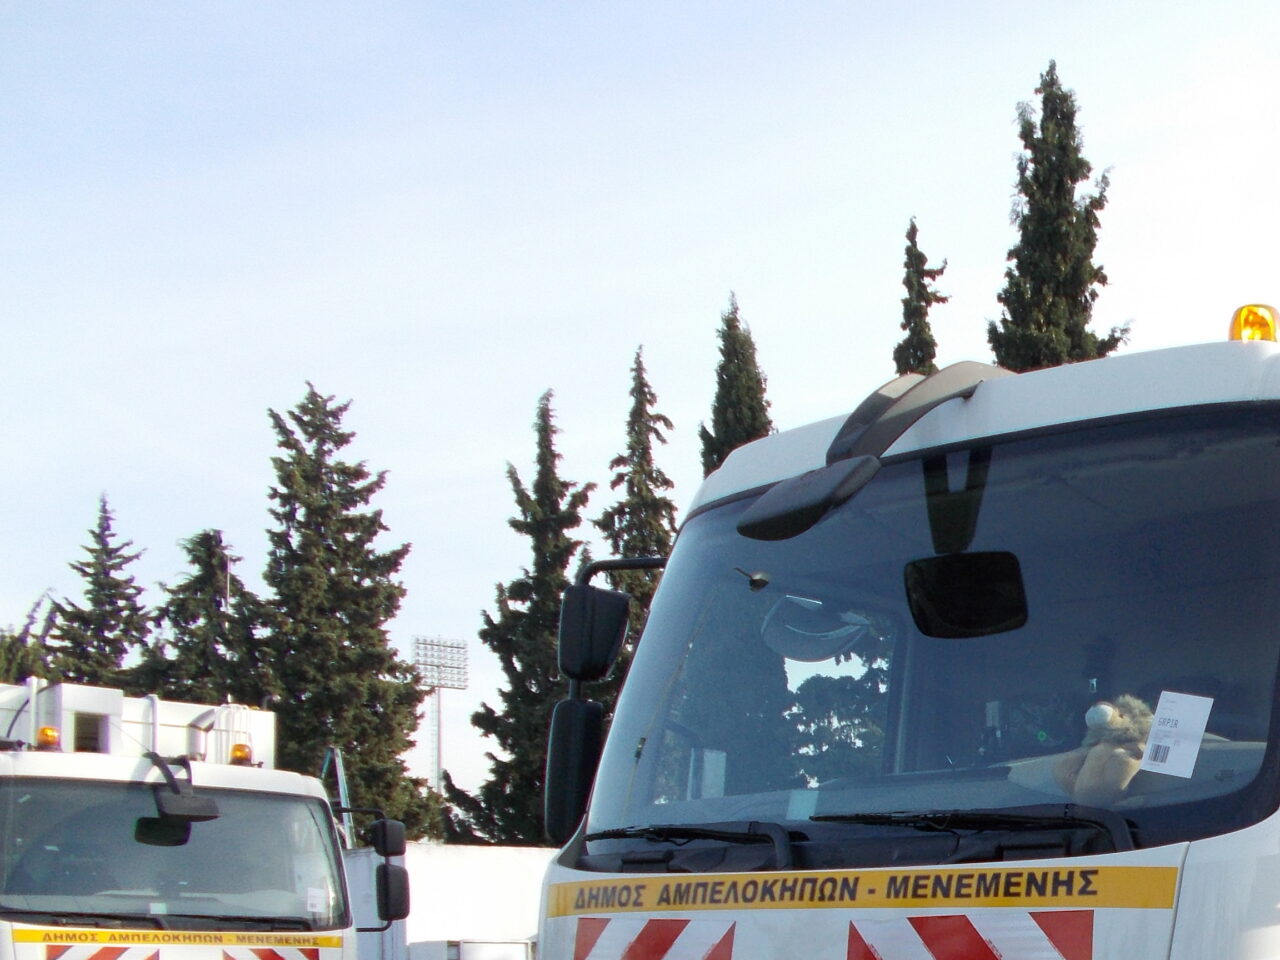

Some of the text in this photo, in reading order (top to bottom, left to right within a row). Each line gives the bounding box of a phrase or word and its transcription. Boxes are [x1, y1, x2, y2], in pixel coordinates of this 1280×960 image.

[574, 884, 647, 910] ΔΗΜΟΣ
[656, 876, 860, 907] ΑΜΠΕΛΟΚΗΠΩΝ
[886, 869, 1099, 900] ΜΕΝΕΜΕΝΗΣ
[42, 931, 98, 943] ΔΗΜΟΣ
[108, 932, 223, 944] ΑΜΠΕΛΟΚΗΠΩΝ
[236, 935, 320, 946] ΜΕΝΕΜΕΝΗΣ
